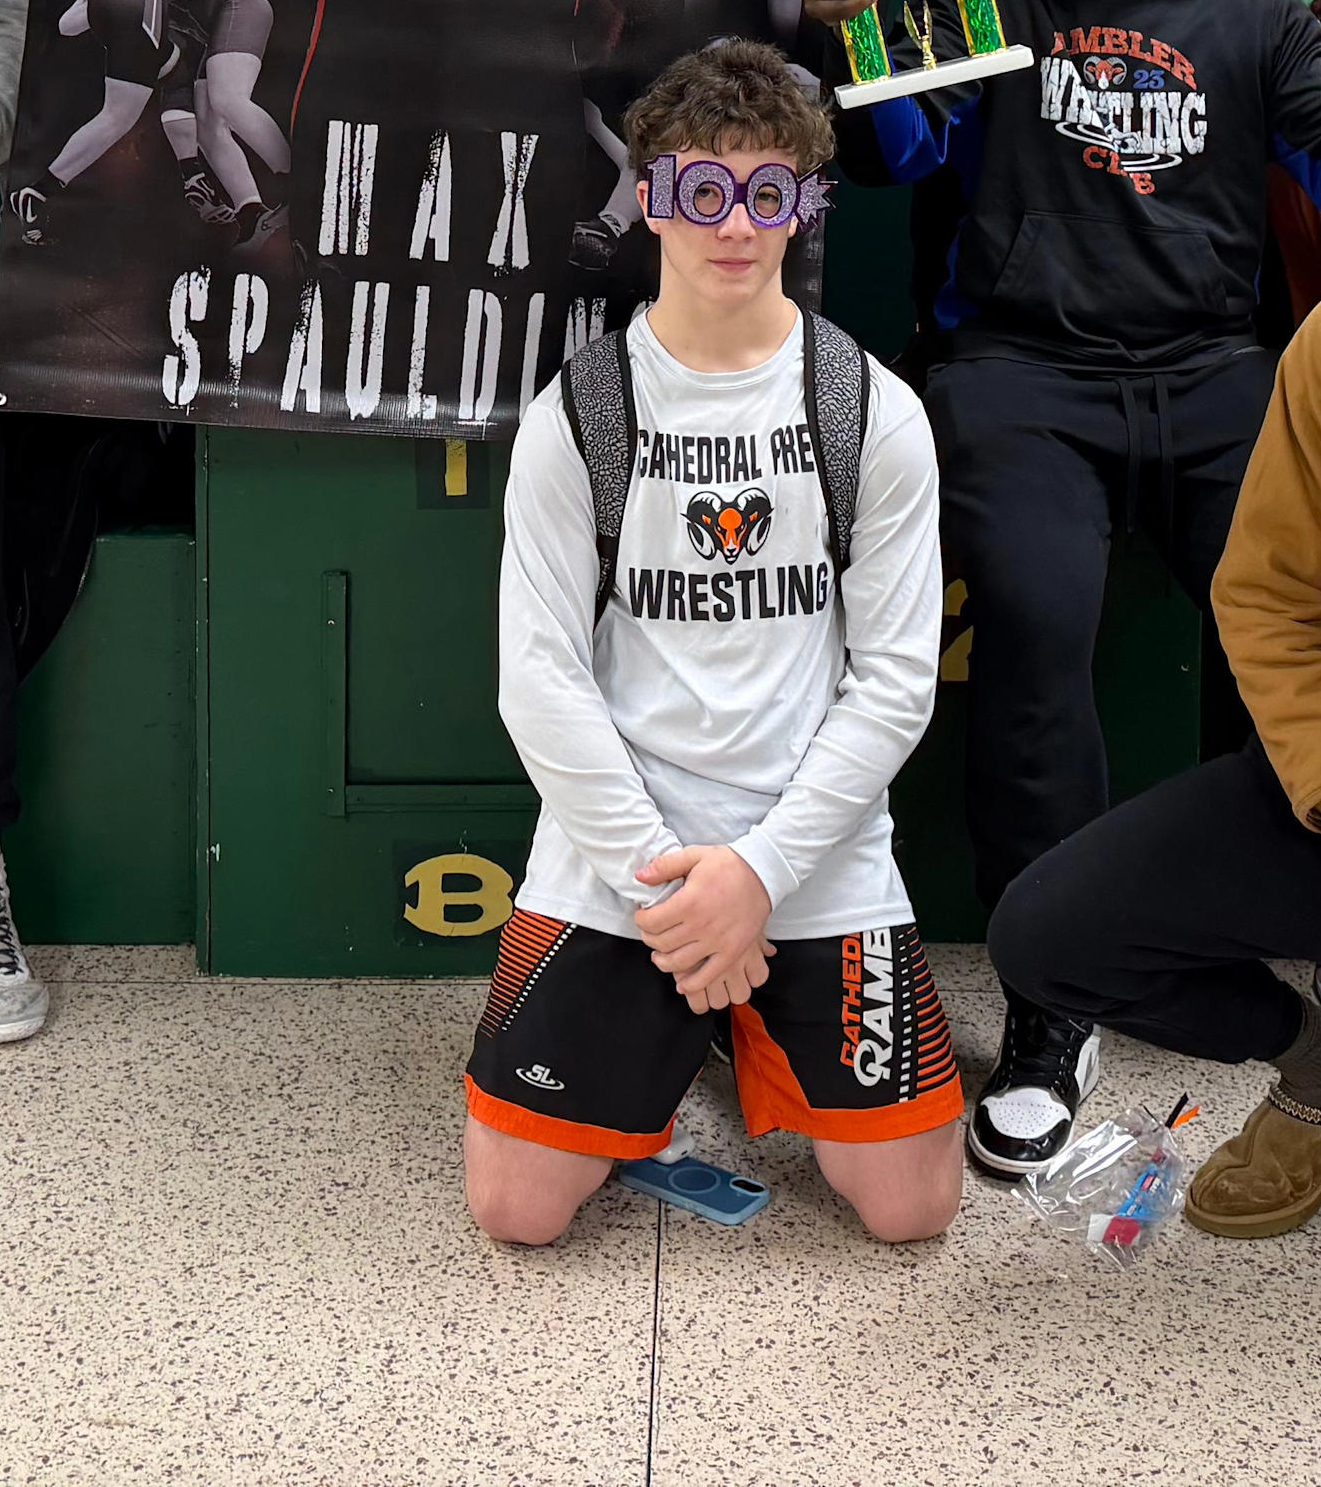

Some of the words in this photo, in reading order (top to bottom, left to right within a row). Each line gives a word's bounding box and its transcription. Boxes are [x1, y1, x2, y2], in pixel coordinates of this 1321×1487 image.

[1133, 69, 1165, 90] 23
[318, 120, 540, 271] MAX
[1083, 145, 1155, 195] CLB
[162, 265, 608, 421] SPAULDI
[638, 429, 762, 484] CAHEDRAL
[770, 423, 815, 476] PRE
[628, 562, 828, 622] WRESTLING
[403, 852, 515, 937] B
